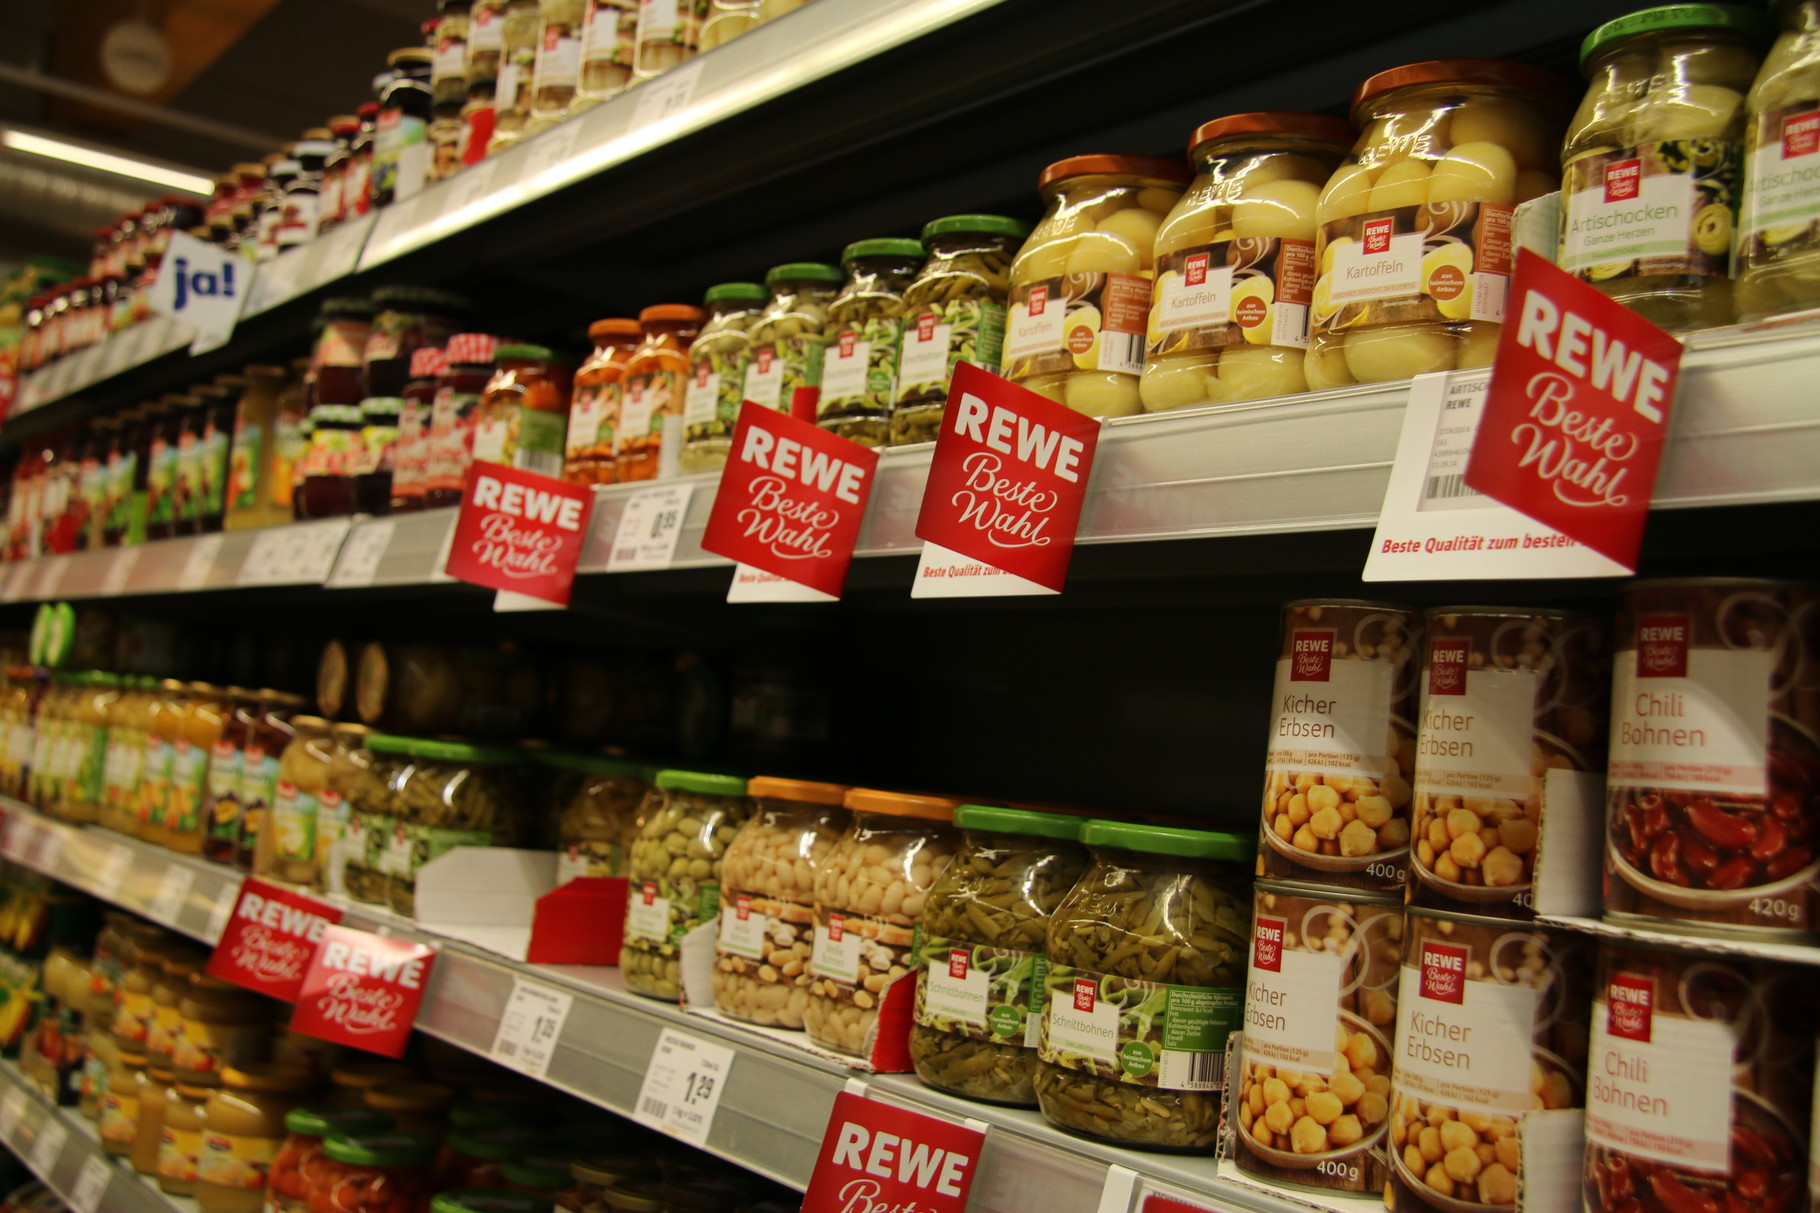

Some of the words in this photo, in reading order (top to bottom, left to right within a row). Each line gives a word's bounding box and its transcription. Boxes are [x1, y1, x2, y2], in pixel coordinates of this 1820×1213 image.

[1785, 118, 1819, 135] REWE
[1607, 166, 1639, 180] REWE
[1366, 224, 1390, 236] REWE
[1570, 204, 1678, 235] Artischocken
[1584, 230, 1615, 247] Ganze
[1618, 226, 1655, 241] Herzen
[1187, 258, 1206, 270] REWE
[1346, 260, 1403, 280] Kartoffeln
[174, 257, 235, 311] ja!
[1171, 291, 1216, 310] Kartoffeln
[1516, 289, 1669, 424] REWE
[1445, 398, 1472, 410] REWE
[1526, 372, 1637, 461] Beste
[954, 392, 1084, 483] REWE
[741, 425, 865, 505] REWE
[1511, 423, 1629, 507] Wahl
[962, 452, 1058, 513] Beste
[473, 475, 584, 531] REWE
[748, 476, 840, 529] Beste
[480, 512, 563, 551] Beste
[952, 490, 1051, 548] Wahl
[737, 508, 832, 559] Wahl
[1381, 538, 1421, 554] Beste
[1425, 534, 1485, 555] Qualität
[1487, 536, 1518, 551] zum
[1522, 533, 1576, 549] besten
[472, 540, 558, 579] Wahl
[923, 566, 947, 578] Beste
[949, 564, 982, 578] Qualität
[1295, 640, 1329, 652] REWE
[1640, 626, 1685, 642] REWE
[1297, 653, 1324, 664] Beste
[1432, 650, 1464, 663] REWE
[1296, 663, 1323, 676] Wahl
[1282, 693, 1337, 715] Kicher
[1635, 693, 1685, 718] Chili
[1279, 717, 1335, 739] Erbsen
[1422, 708, 1474, 732] Kicher
[1420, 734, 1474, 757] Erbsen
[1621, 721, 1706, 747] Bohnen
[238, 891, 331, 944] REWE
[240, 924, 310, 961] Beste
[1256, 926, 1280, 942] REWE
[1257, 940, 1277, 953] Beste
[231, 946, 303, 982] Wahl
[322, 940, 424, 989] REWE
[951, 953, 967, 964] REWE
[1256, 951, 1276, 965] Wahl
[1424, 951, 1463, 971] REWE
[1427, 967, 1456, 982] Beste
[327, 972, 404, 1009] Beste
[930, 980, 984, 1003] Schnittbohnen
[1076, 984, 1094, 995] REWE
[1425, 980, 1456, 995] Wahl
[1610, 984, 1649, 1005] REWE
[318, 997, 397, 1034] Wahl
[1052, 1013, 1114, 1039] Schnittbohnen
[1246, 1002, 1286, 1031] Erbsen
[1411, 1010, 1471, 1042] Kicher
[1407, 1035, 1471, 1070] Erbsen
[1605, 1050, 1648, 1084] Chili
[1593, 1076, 1668, 1117] Bohnen
[832, 1121, 969, 1198] REWE
[838, 1178, 938, 1213] Best
